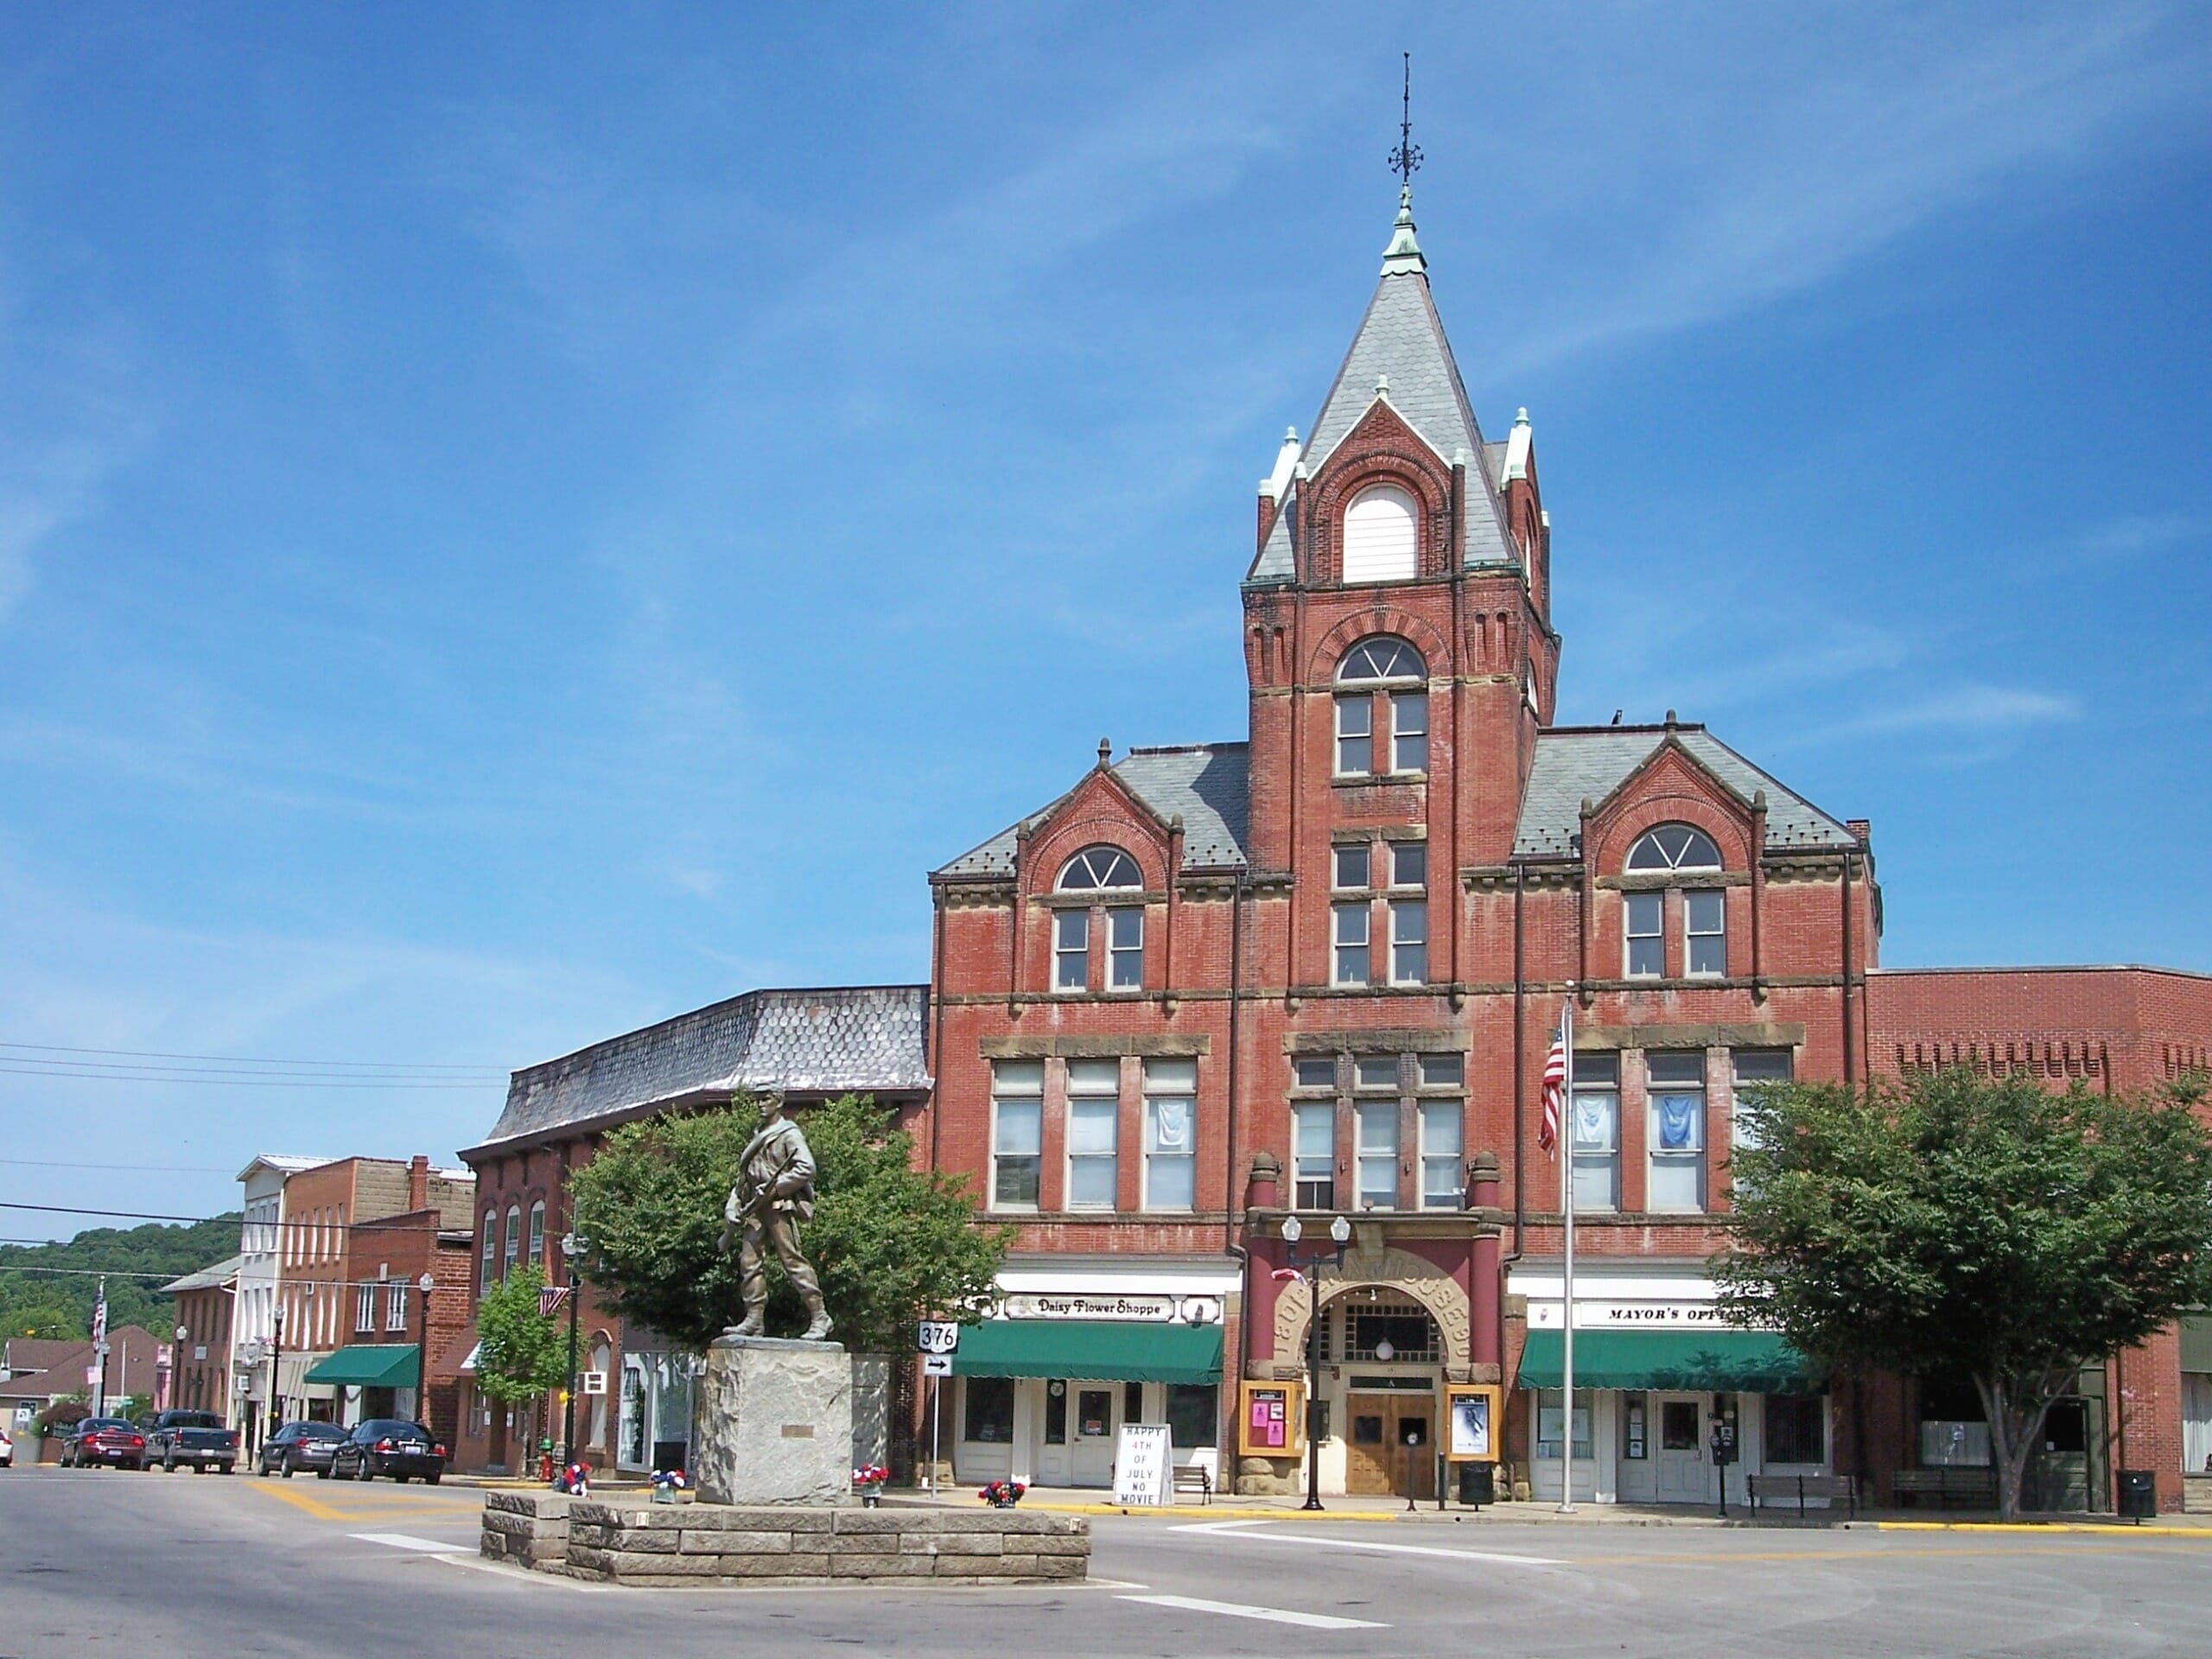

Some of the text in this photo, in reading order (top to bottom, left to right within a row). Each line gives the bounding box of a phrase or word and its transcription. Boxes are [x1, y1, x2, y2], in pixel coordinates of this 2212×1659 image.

[1038, 1299, 1160, 1316] Daisy Flower Shoppe
[1609, 1307, 1679, 1319] MAYOR'S
[922, 1327, 954, 1345] 376
[1127, 1427, 1162, 1436] HAPPY
[1133, 1441, 1152, 1450] 4TH
[1135, 1455, 1147, 1464] OF
[1127, 1470, 1153, 1478] JULY
[1133, 1482, 1146, 1491] NO
[1122, 1494, 1154, 1504] MOVIE
